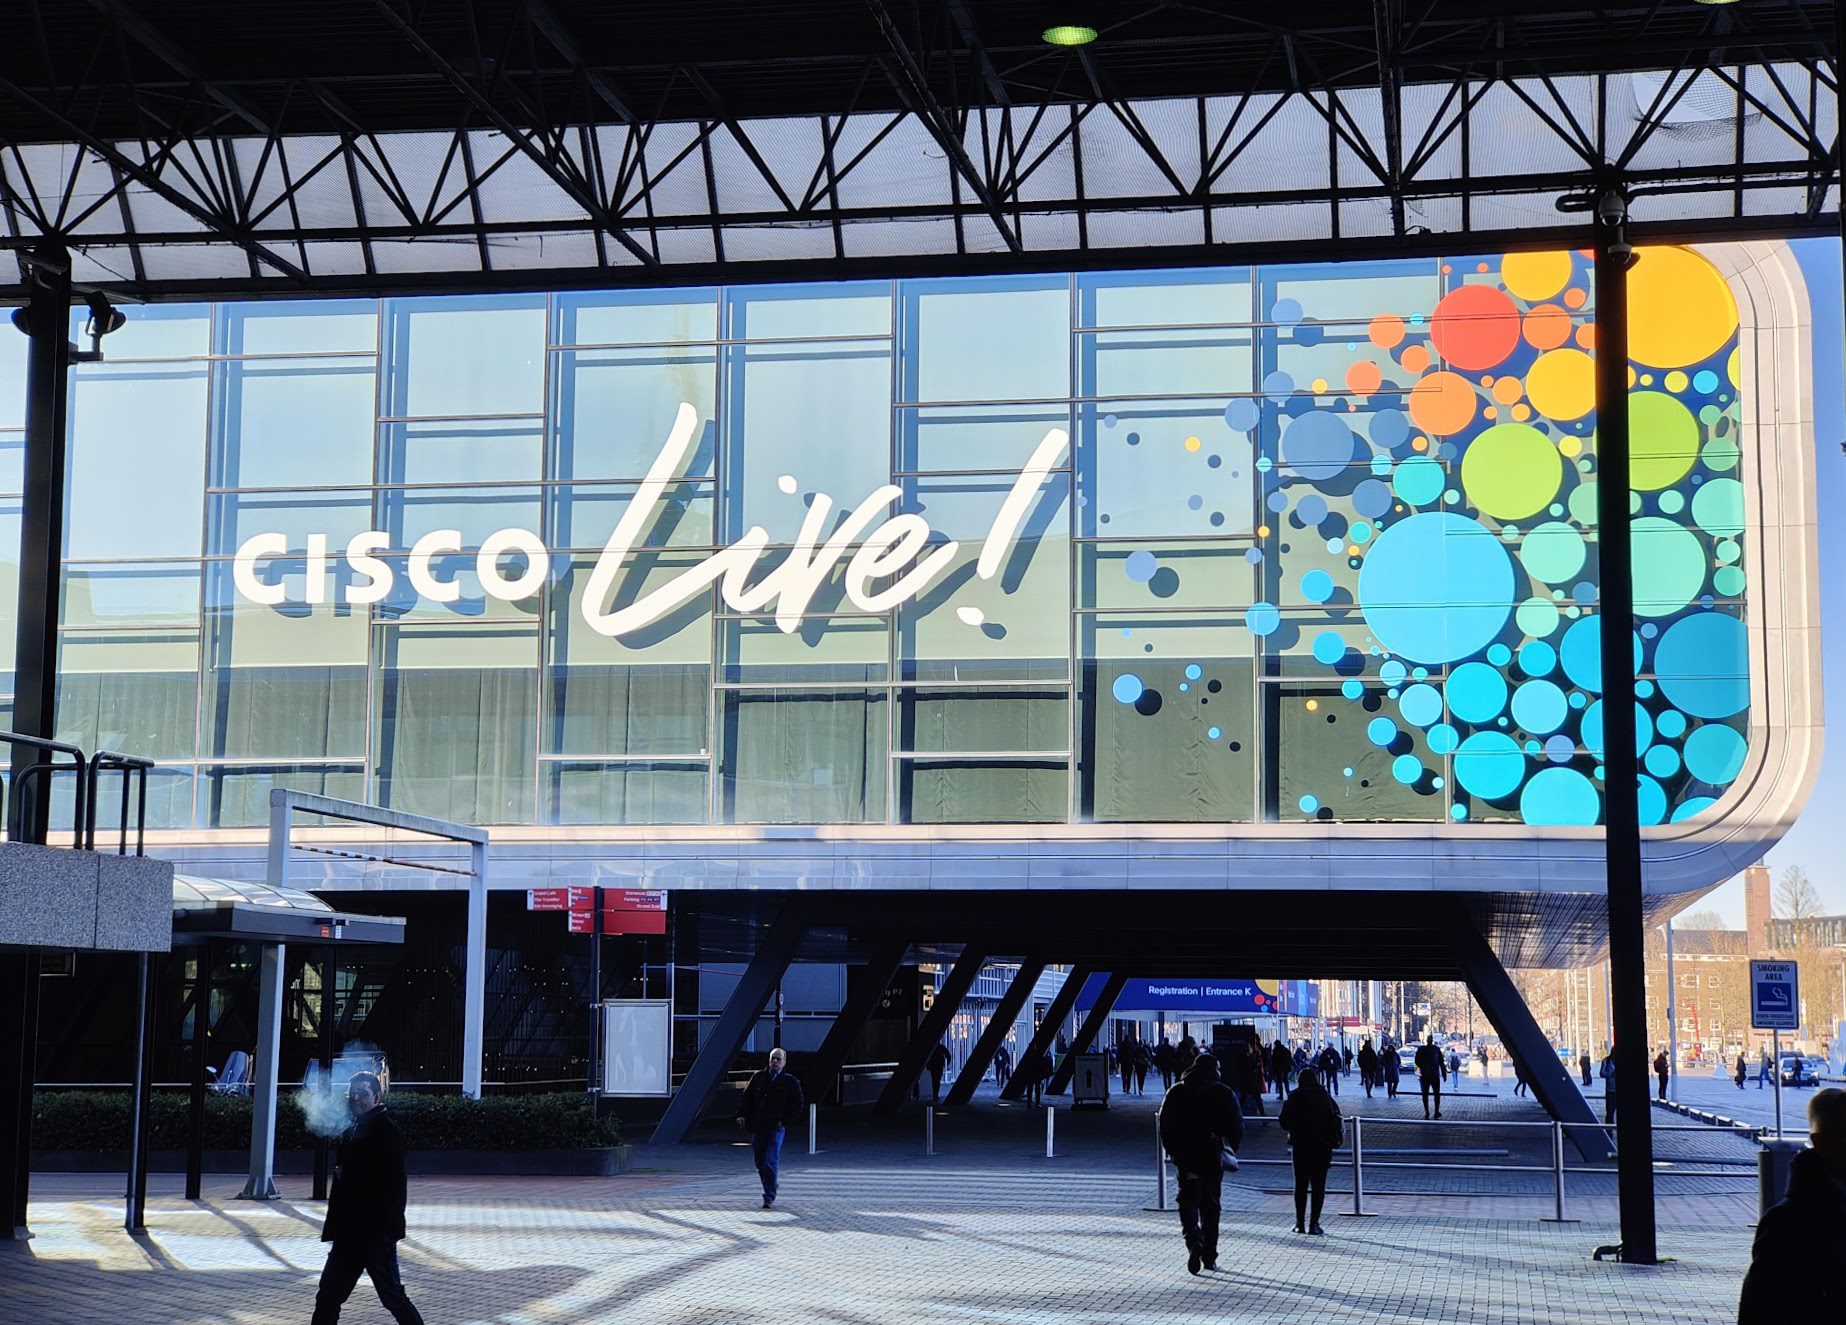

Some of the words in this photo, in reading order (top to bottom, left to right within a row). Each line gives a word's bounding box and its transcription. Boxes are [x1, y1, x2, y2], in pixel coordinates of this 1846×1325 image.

[233, 528, 550, 605] CISCO
[1757, 964, 1790, 972] SMOKING
[1148, 985, 1198, 996] Registration
[1206, 986, 1243, 996] Entrance
[1244, 986, 1252, 996] K
